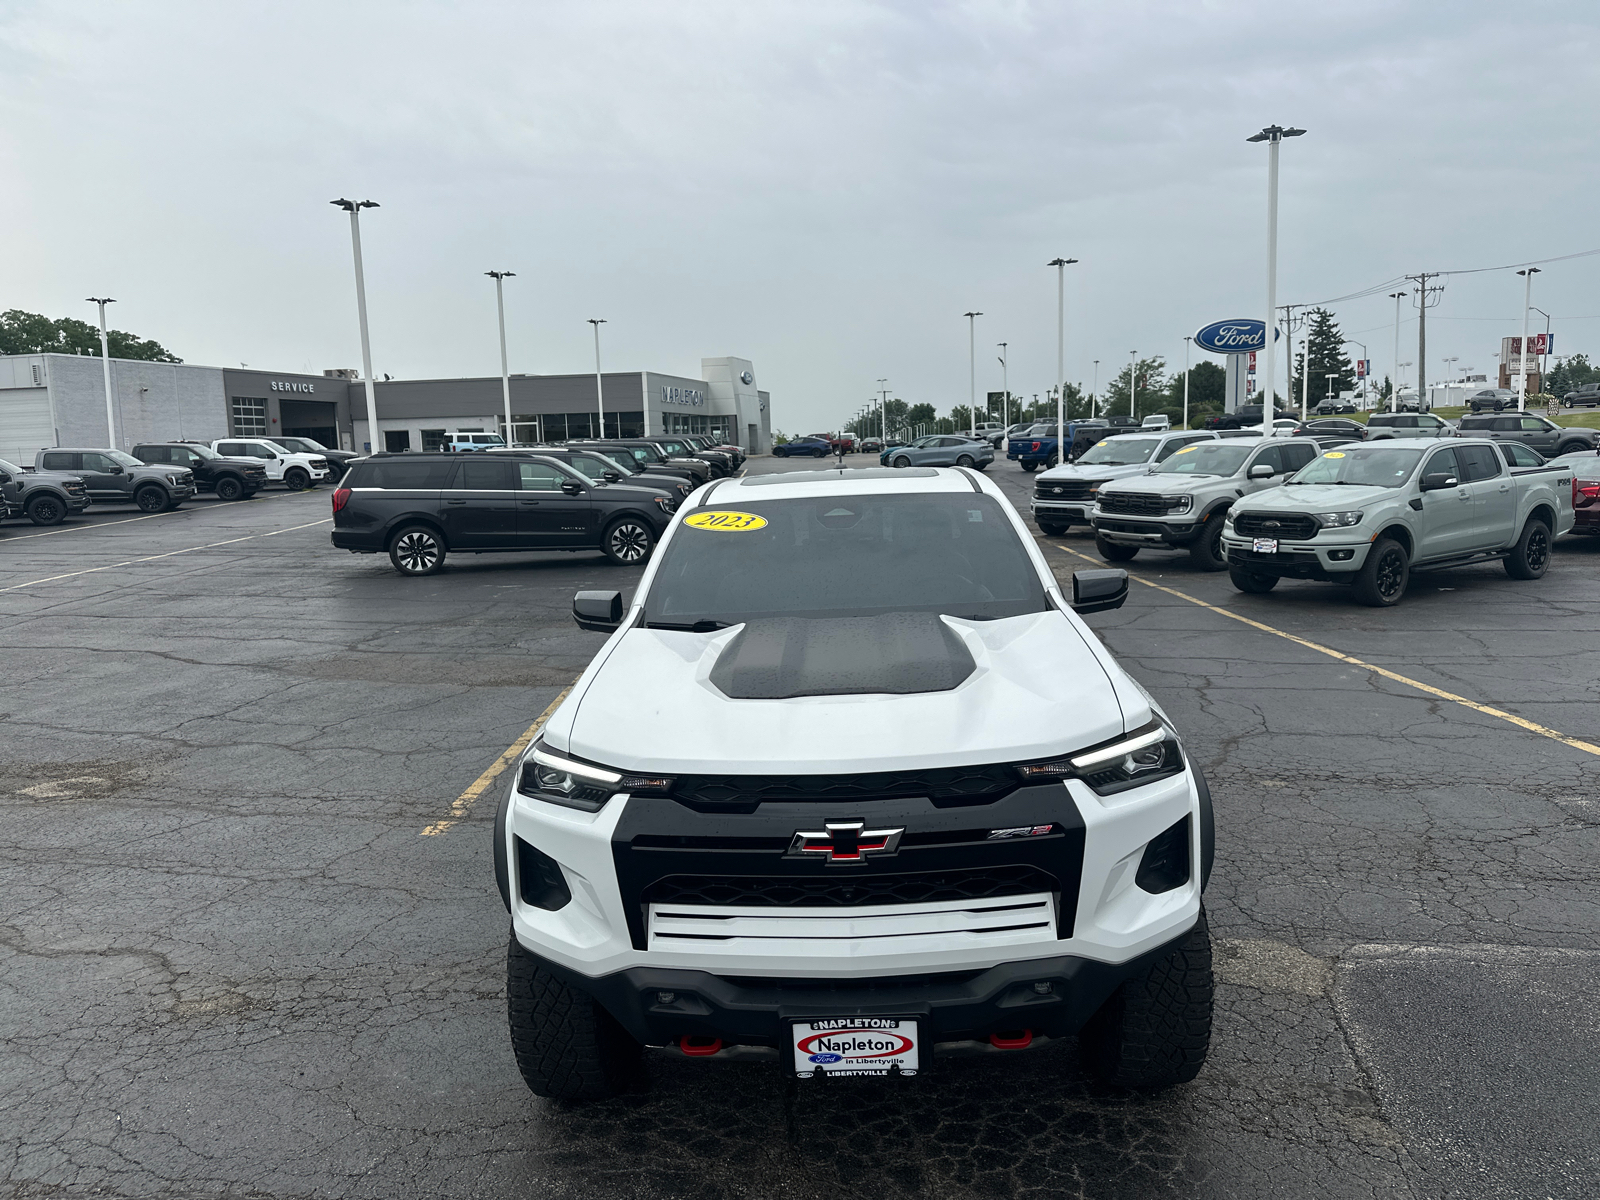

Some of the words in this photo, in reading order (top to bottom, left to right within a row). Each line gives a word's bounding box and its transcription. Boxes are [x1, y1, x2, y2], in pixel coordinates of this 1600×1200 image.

[1214, 325, 1264, 346] Ford
[271, 381, 314, 393] SERVICE
[661, 385, 704, 406] NAPLETON
[695, 515, 756, 528] 2023
[986, 824, 1053, 840] ZR2
[818, 1018, 891, 1030] NAPLETON
[818, 1037, 895, 1054] Napleton
[815, 1054, 836, 1063] Ford
